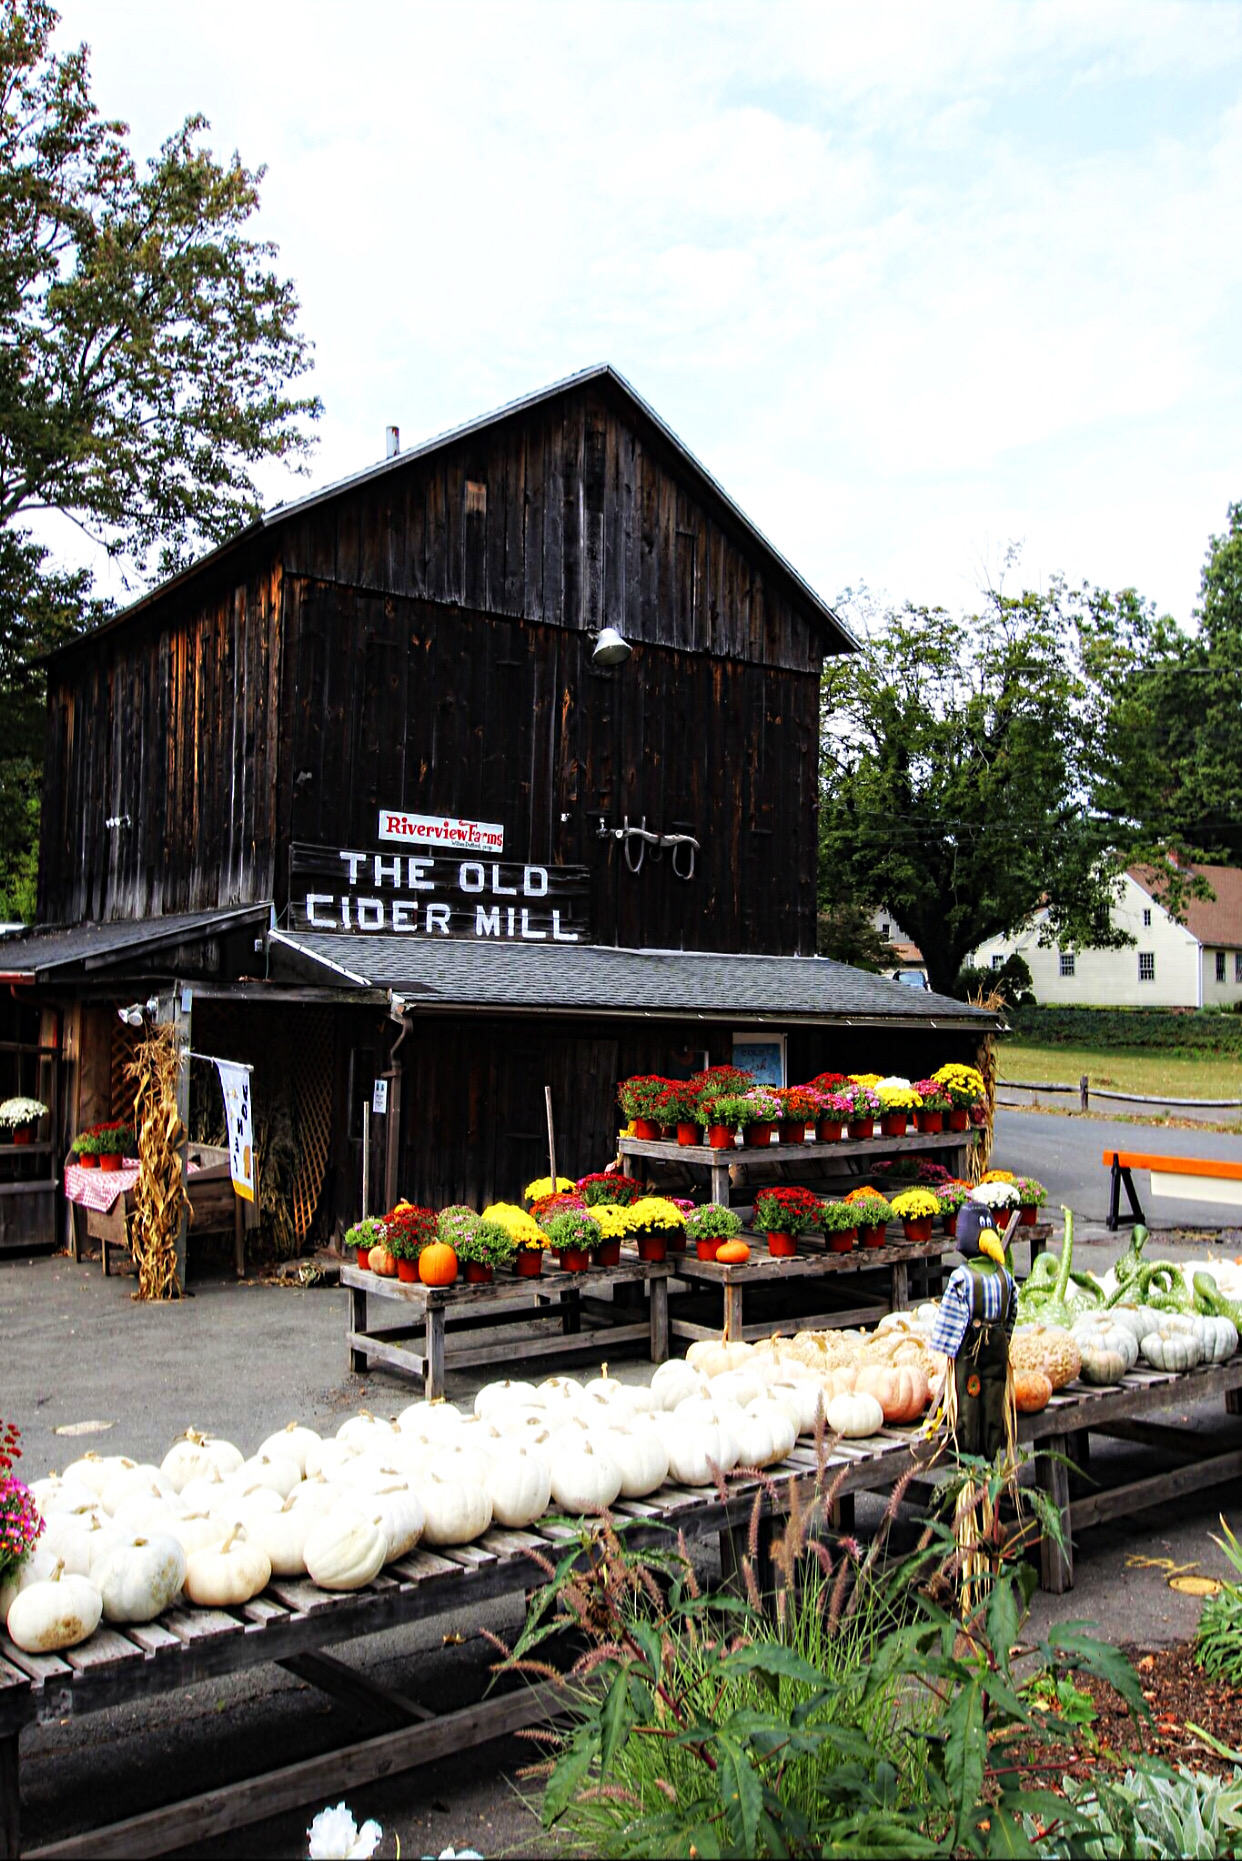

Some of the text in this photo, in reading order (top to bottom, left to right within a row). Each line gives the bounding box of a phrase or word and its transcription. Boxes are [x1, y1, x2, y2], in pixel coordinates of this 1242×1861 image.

[387, 816, 503, 846] Riverview Farms
[339, 851, 549, 897] THE OLD
[306, 894, 579, 941] CIDER MILL
